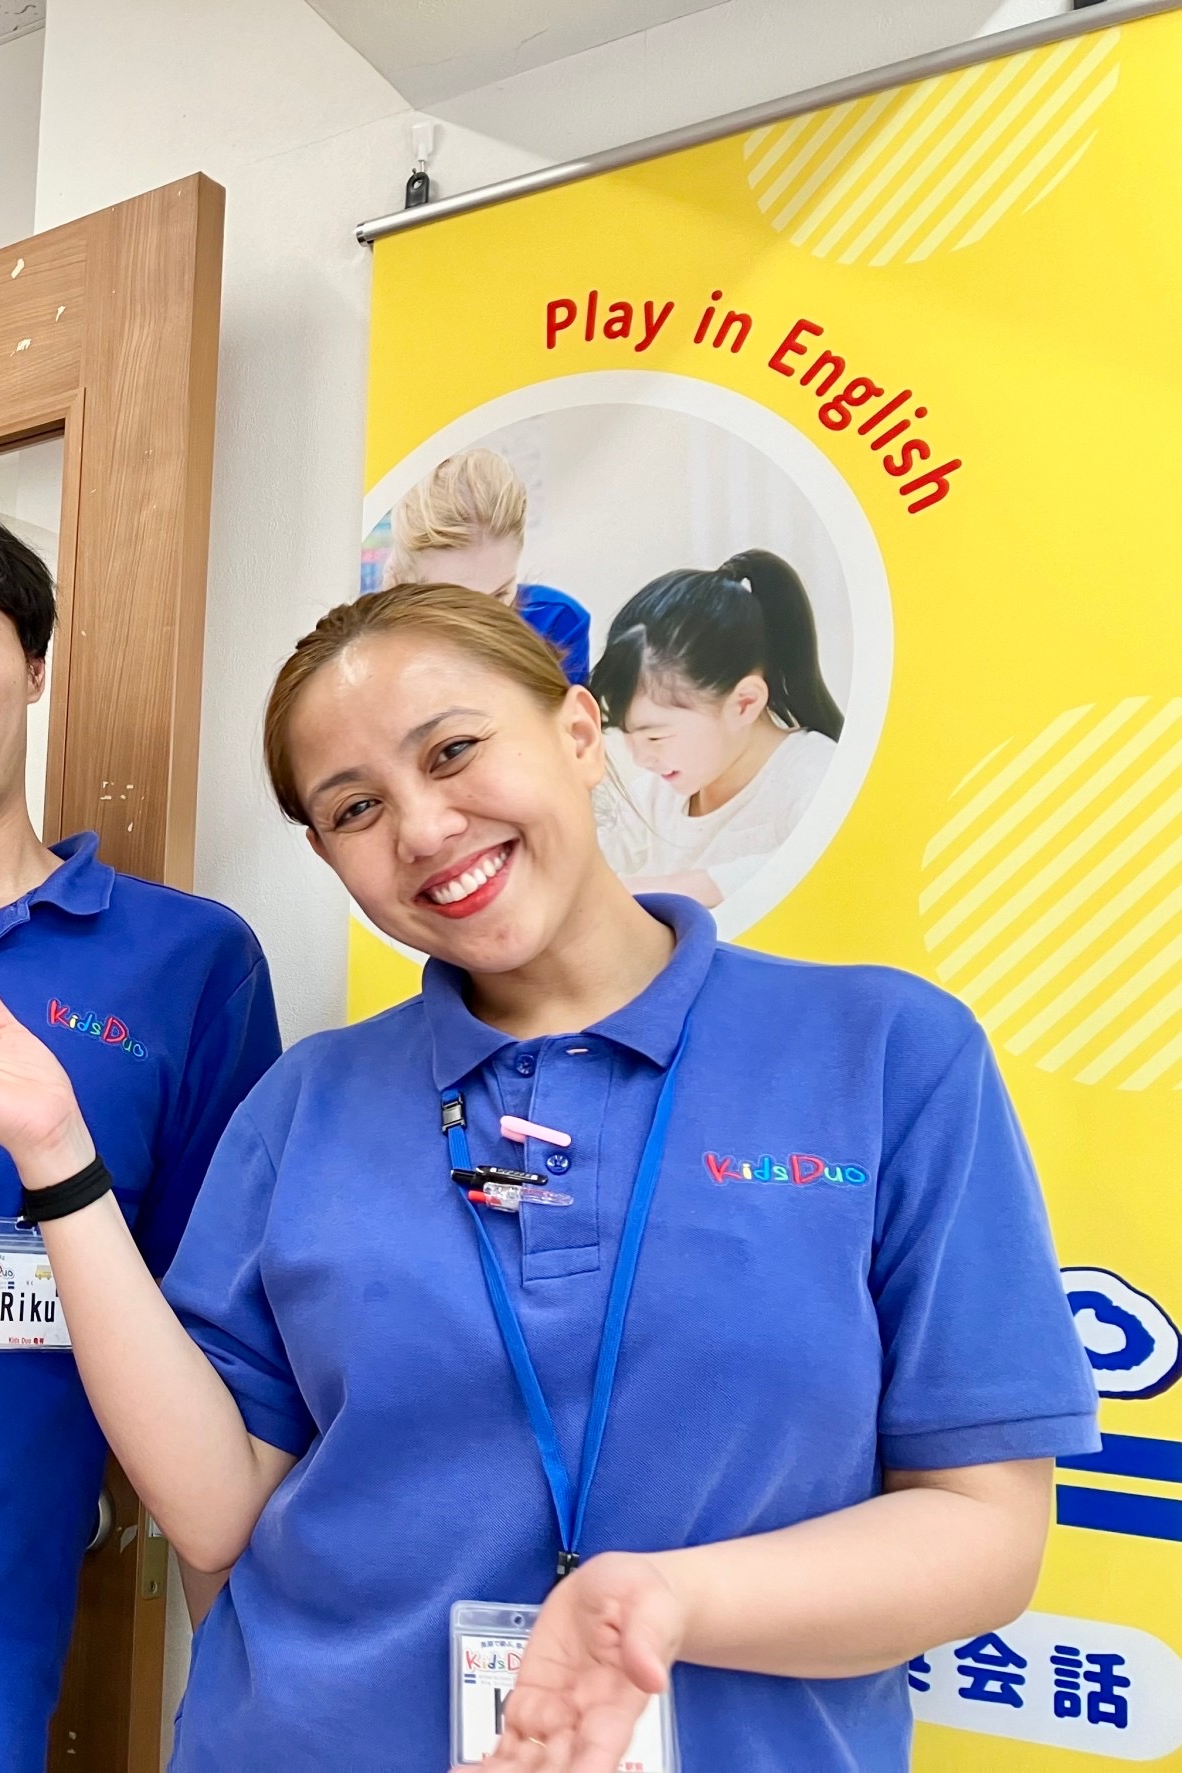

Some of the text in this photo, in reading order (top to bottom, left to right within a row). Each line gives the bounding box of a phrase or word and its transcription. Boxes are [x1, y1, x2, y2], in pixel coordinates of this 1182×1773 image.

[546, 289, 962, 515] Play in English
[0, 1291, 56, 1323] Riku
[909, 1631, 1132, 1730] 会話
